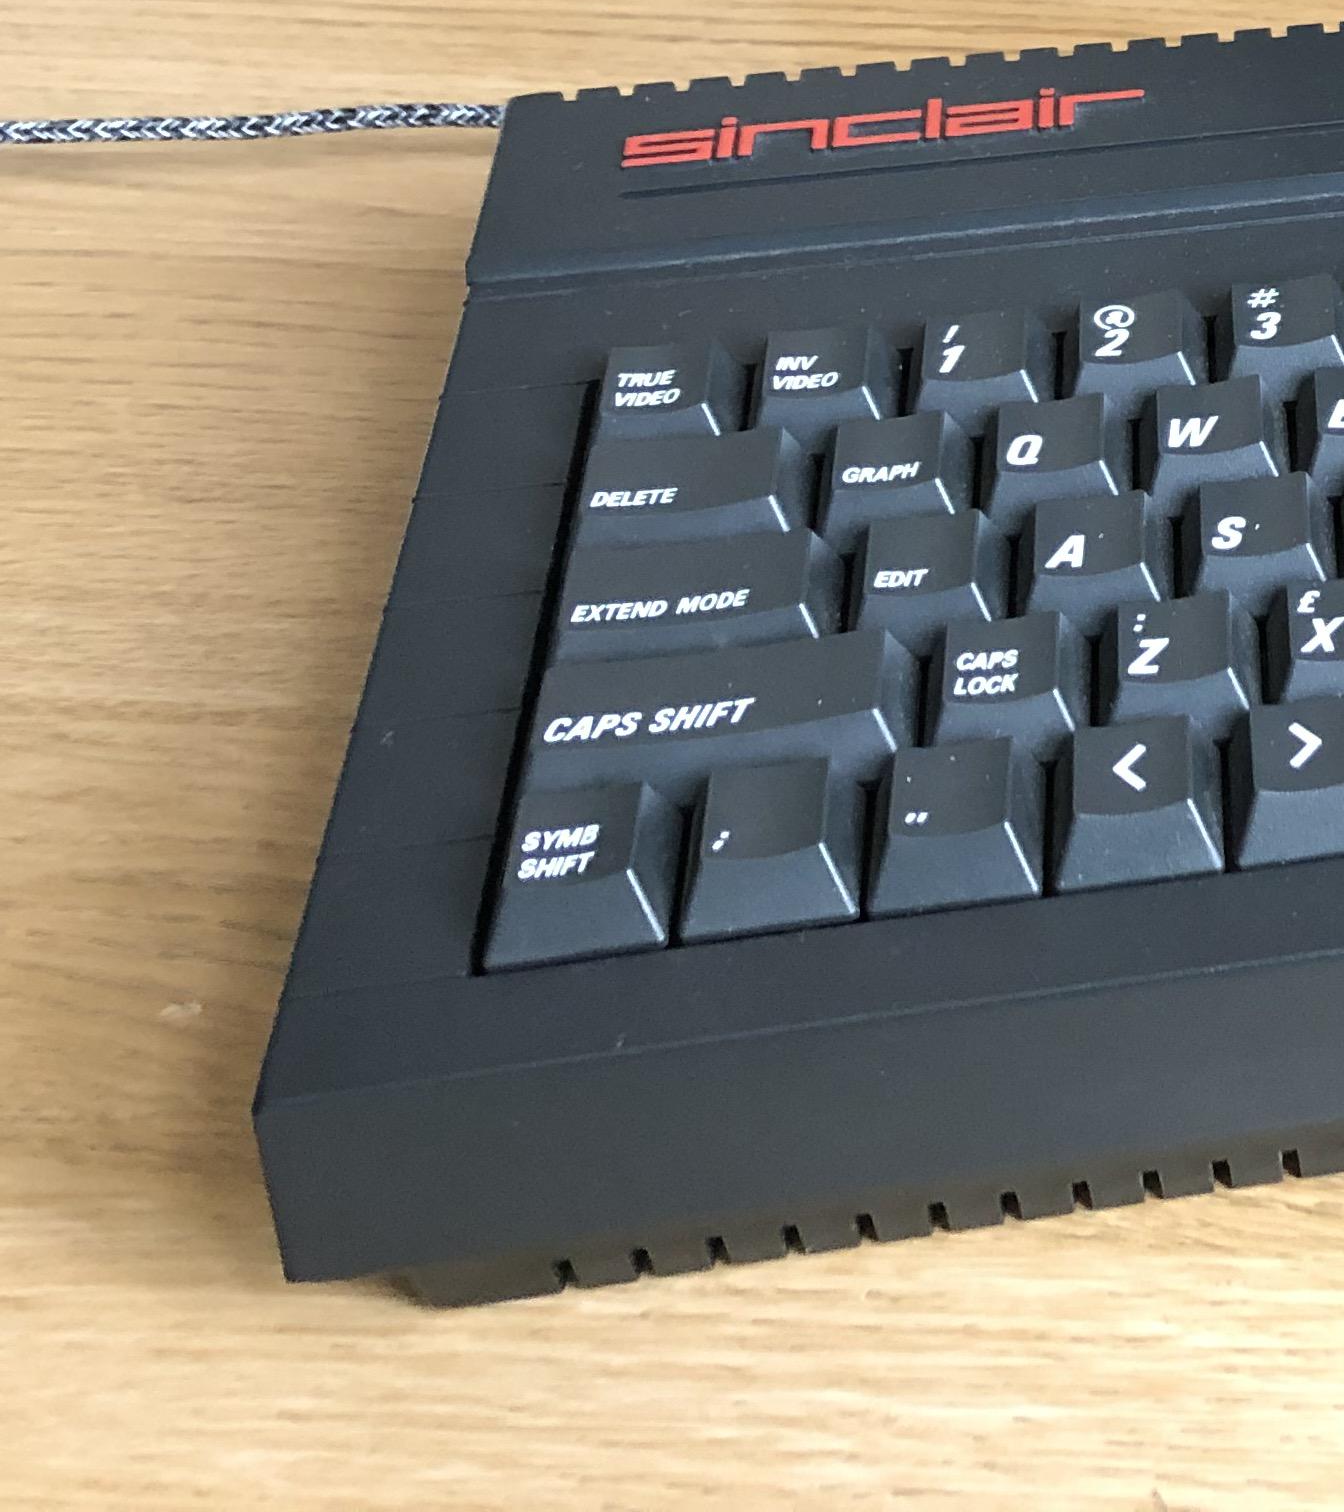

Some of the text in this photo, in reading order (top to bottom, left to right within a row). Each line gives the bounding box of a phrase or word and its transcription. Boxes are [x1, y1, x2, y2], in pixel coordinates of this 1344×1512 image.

[620, 87, 1146, 168] sinclair
[1246, 287, 1280, 309] #
[1093, 304, 1135, 331] @
[1249, 311, 1282, 340] 3
[1094, 328, 1130, 357] 2
[775, 355, 819, 371] INV
[938, 344, 966, 374] 1
[617, 369, 676, 388] TRUE
[772, 371, 839, 390] VIDEO
[614, 388, 681, 407] VIDEO
[1167, 415, 1219, 448] W
[1006, 434, 1043, 466] Q
[841, 461, 920, 484] GRAPH
[589, 487, 679, 508] DELETE
[1211, 516, 1247, 550] S
[1044, 534, 1085, 569] A
[873, 568, 929, 589] EDIT
[570, 588, 750, 623] EXTEND MODE
[1296, 590, 1321, 614] £
[1132, 613, 1146, 633] :
[956, 649, 1019, 671] CAPS
[1127, 637, 1170, 675] Z
[953, 672, 1019, 696] LOCK
[543, 697, 755, 743] CAPS SHIFT
[521, 824, 600, 852] SYMB
[517, 850, 596, 880] SHIFT
